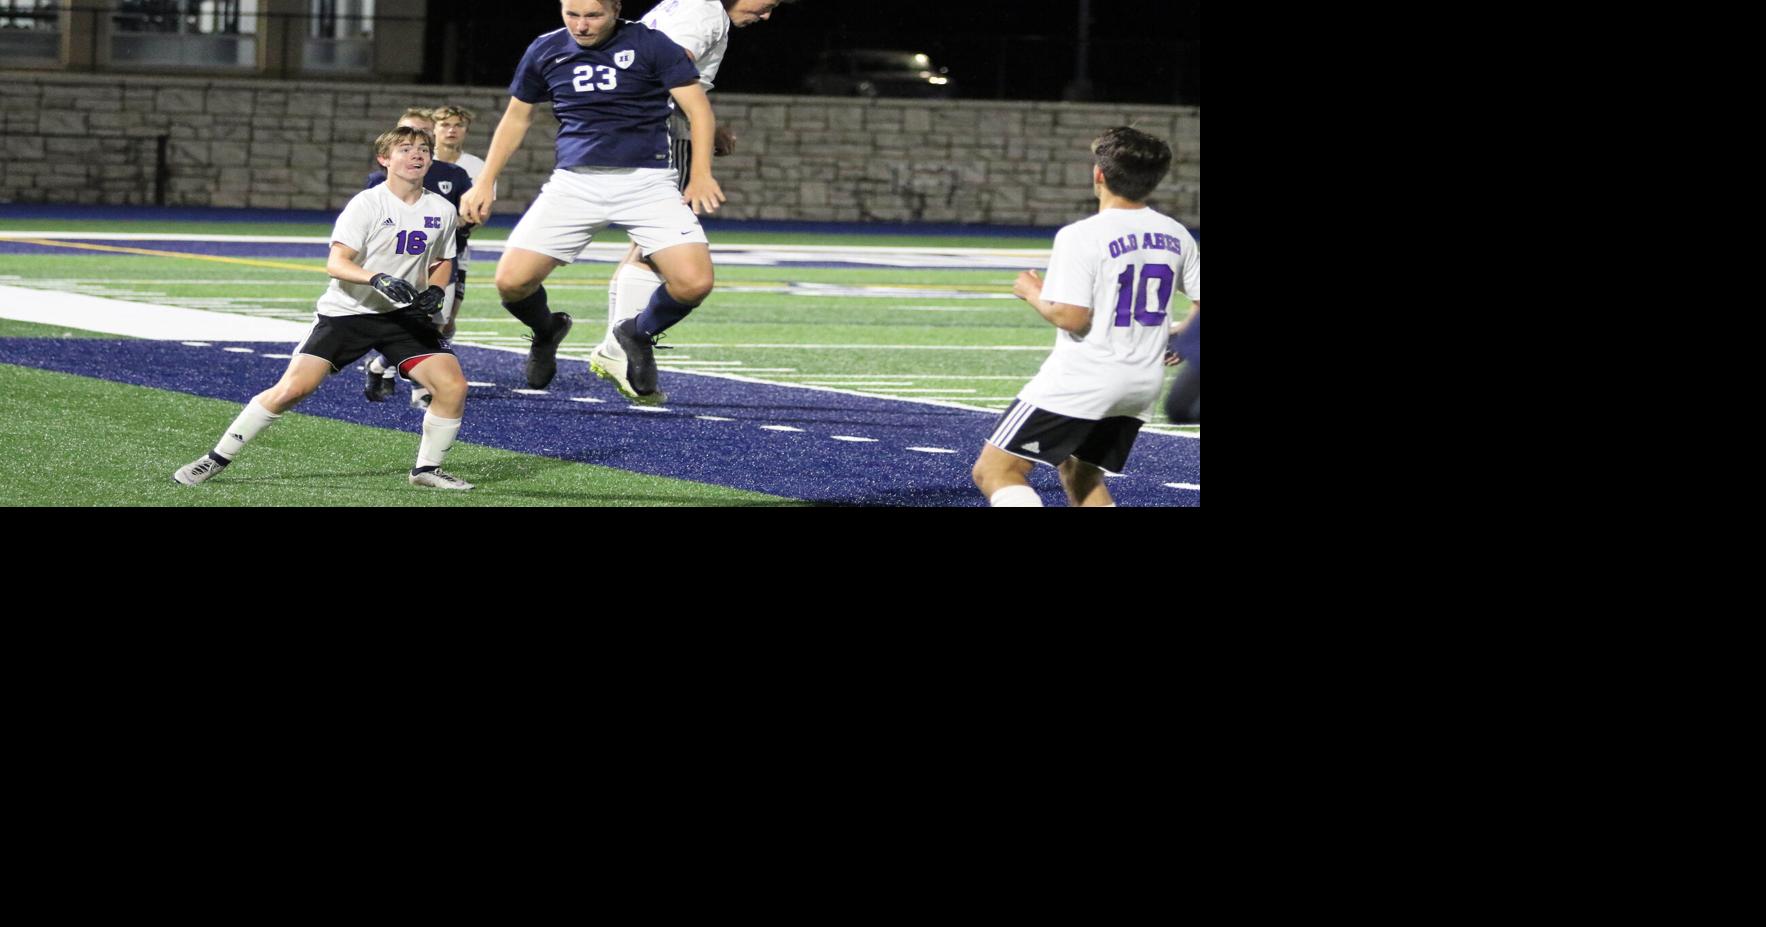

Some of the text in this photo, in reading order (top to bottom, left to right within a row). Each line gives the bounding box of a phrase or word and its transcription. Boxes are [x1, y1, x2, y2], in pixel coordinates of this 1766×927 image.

[572, 64, 617, 92] 23
[395, 230, 428, 255] 16
[1109, 233, 1138, 258] OLD
[1114, 263, 1175, 327] 10
